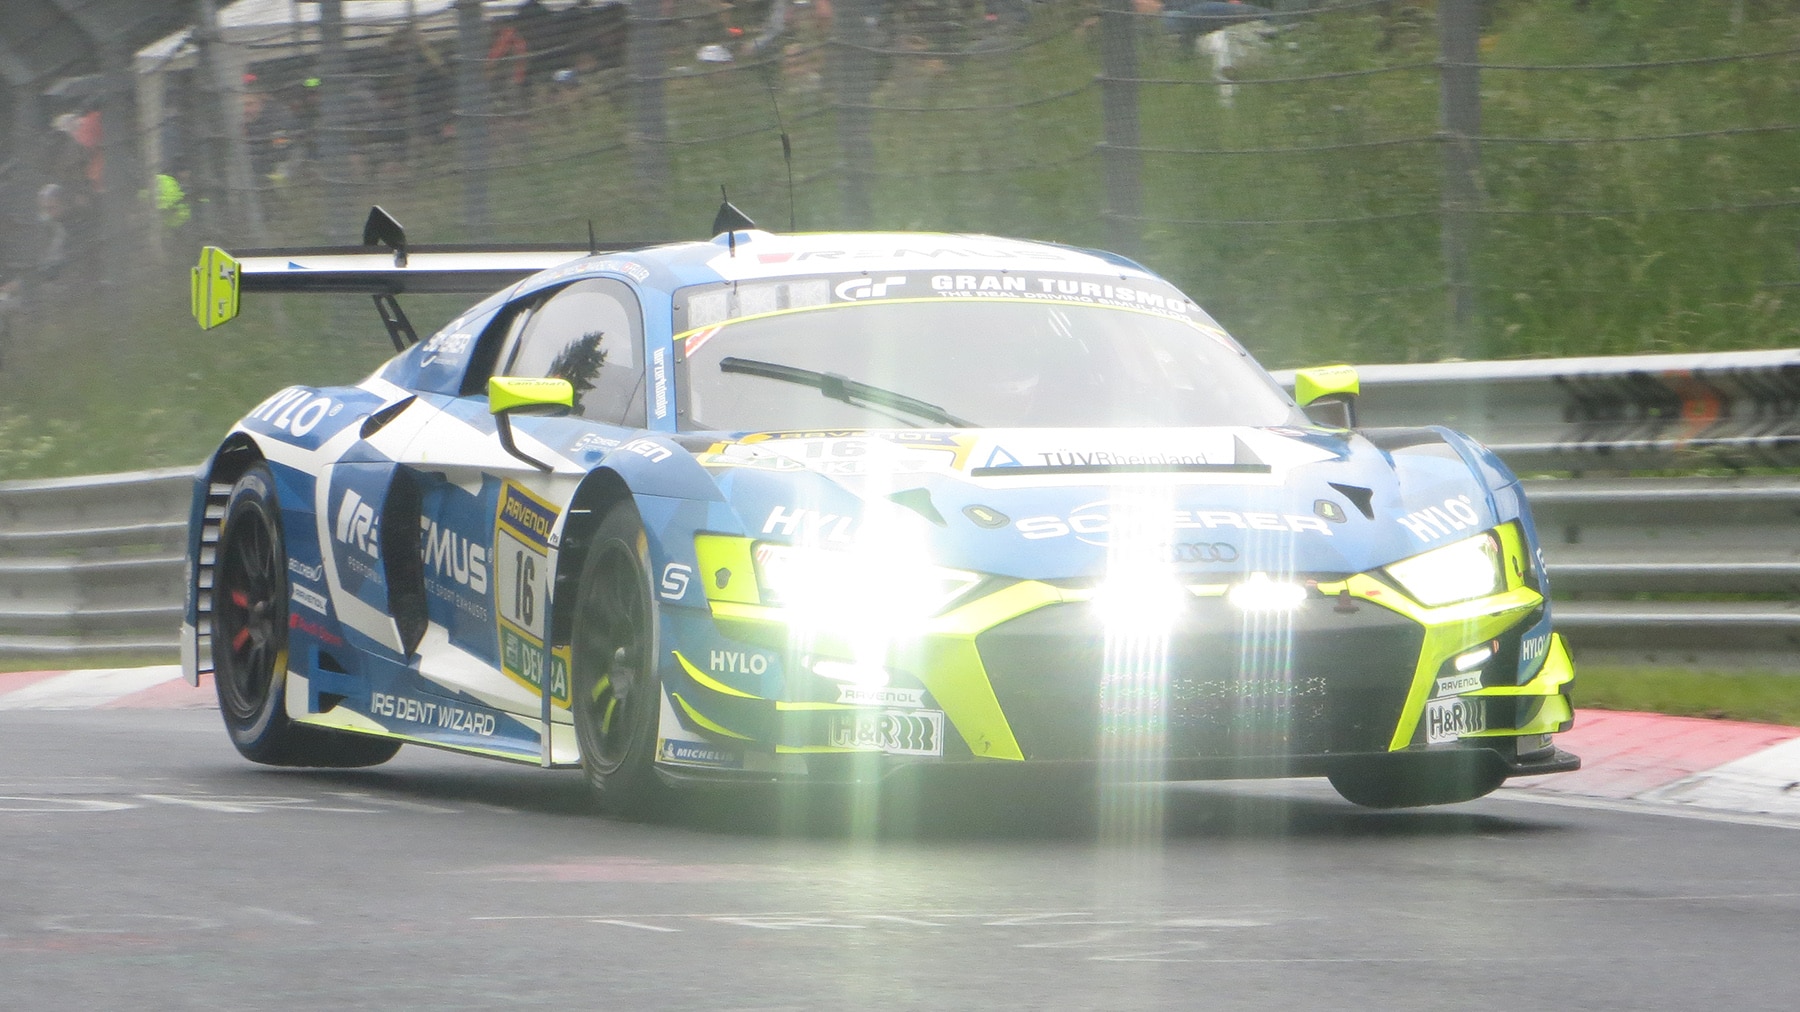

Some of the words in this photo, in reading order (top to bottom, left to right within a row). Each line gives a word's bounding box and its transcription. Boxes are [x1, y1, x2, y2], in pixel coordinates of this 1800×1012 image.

[931, 275, 1027, 292] GRAN
[1038, 278, 1187, 314] TURISMO
[1024, 292, 1093, 304] DRIVING
[780, 430, 944, 442] RAVENOL
[803, 440, 868, 458] 16
[505, 496, 551, 538] RAVENOL
[515, 550, 535, 625] 16
[710, 650, 768, 675] HYLO
[844, 689, 916, 703] RAVENOL
[1440, 677, 1479, 691] RAVENOL
[371, 692, 393, 715] IRS
[396, 698, 437, 725] DENT
[437, 707, 496, 737] WIZARD
[1429, 706, 1466, 742] H&R
[831, 712, 900, 748] H&R
[676, 747, 735, 762] MICHELIN
